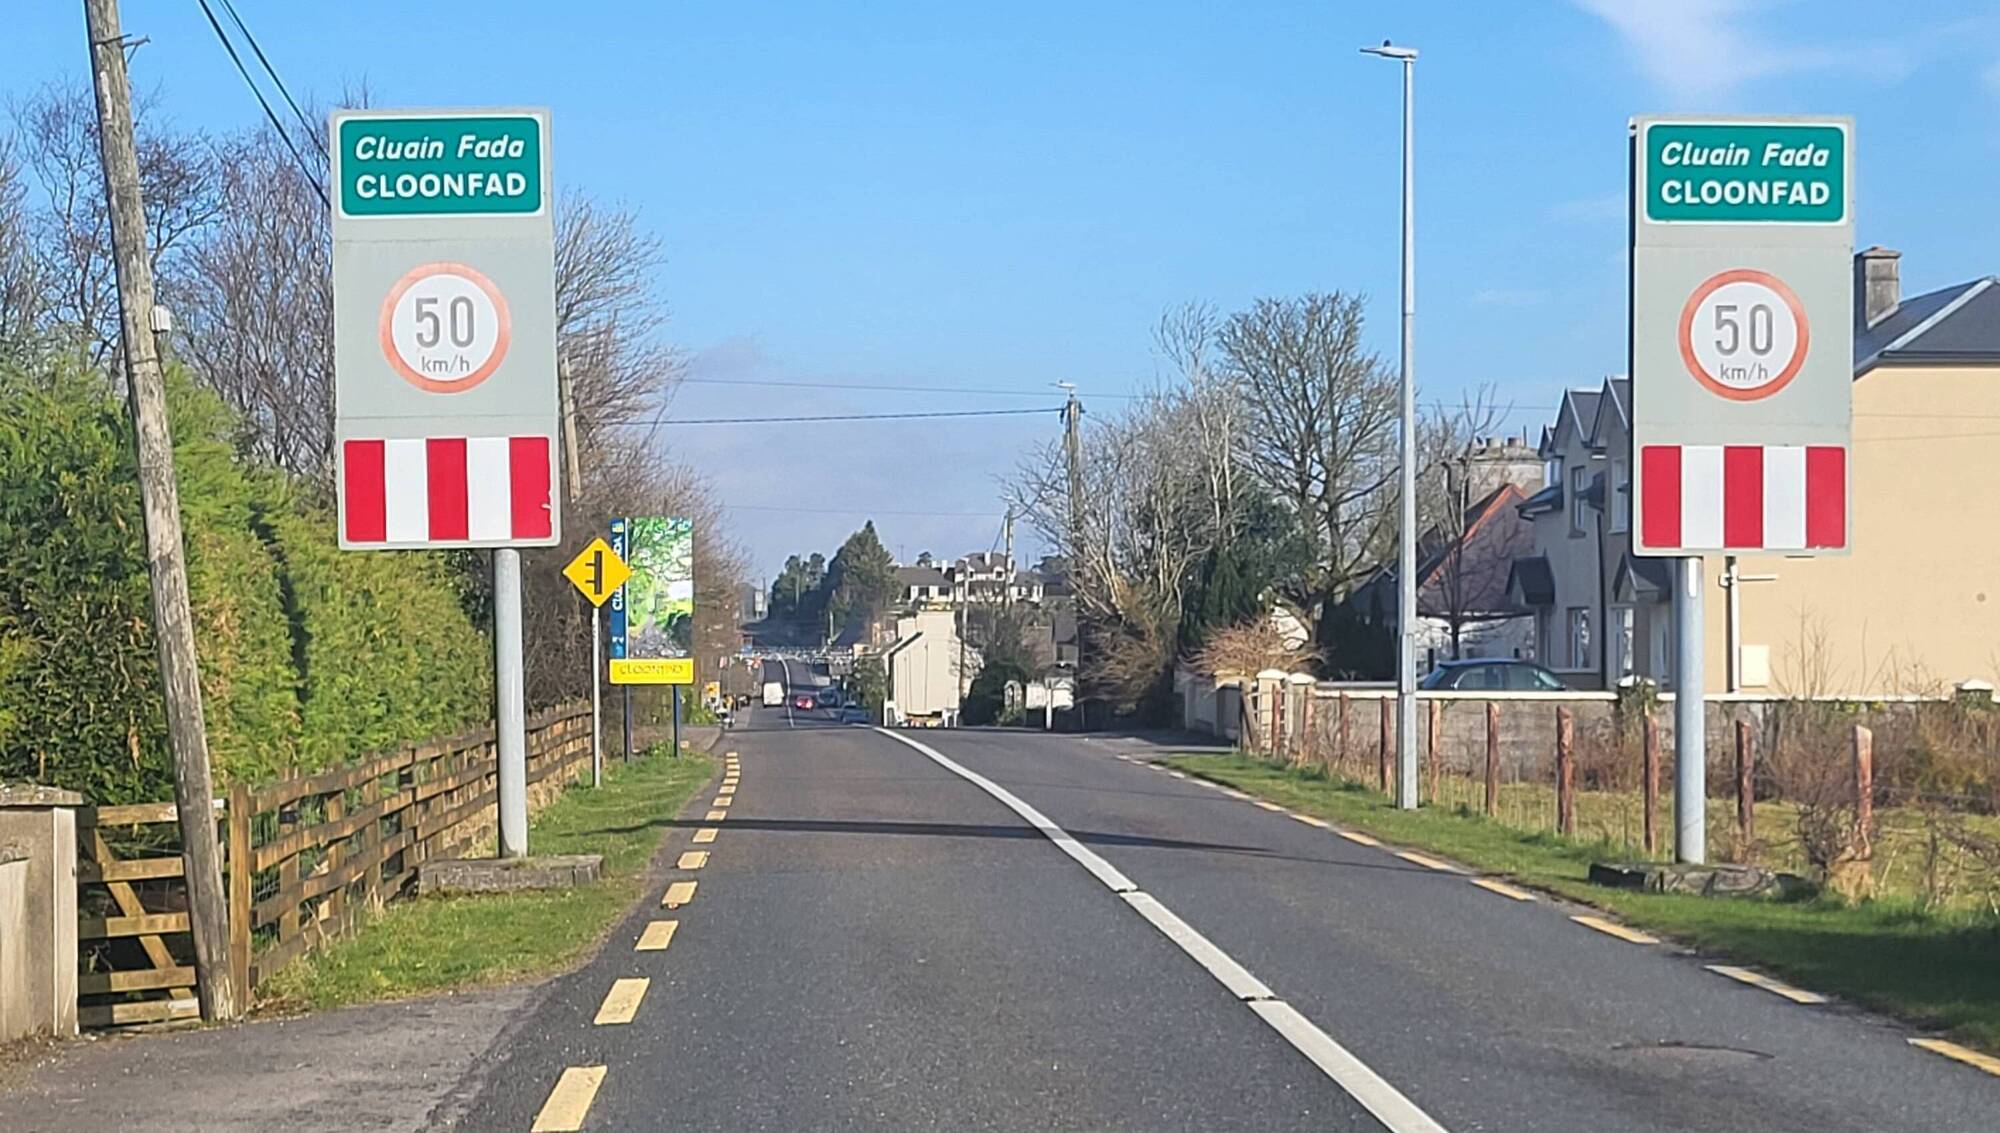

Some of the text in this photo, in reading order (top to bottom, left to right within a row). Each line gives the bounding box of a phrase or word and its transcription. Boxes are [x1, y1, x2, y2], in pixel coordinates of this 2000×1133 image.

[356, 134, 525, 160] Cluain Fada
[1661, 142, 1829, 167] Cluain Fada
[356, 174, 526, 198] CLOONFAD
[1661, 180, 1830, 205] CLOONFAD
[415, 296, 475, 348] 50
[1714, 304, 1773, 356] 50
[421, 354, 470, 372] km/h
[1720, 362, 1768, 380] km/h
